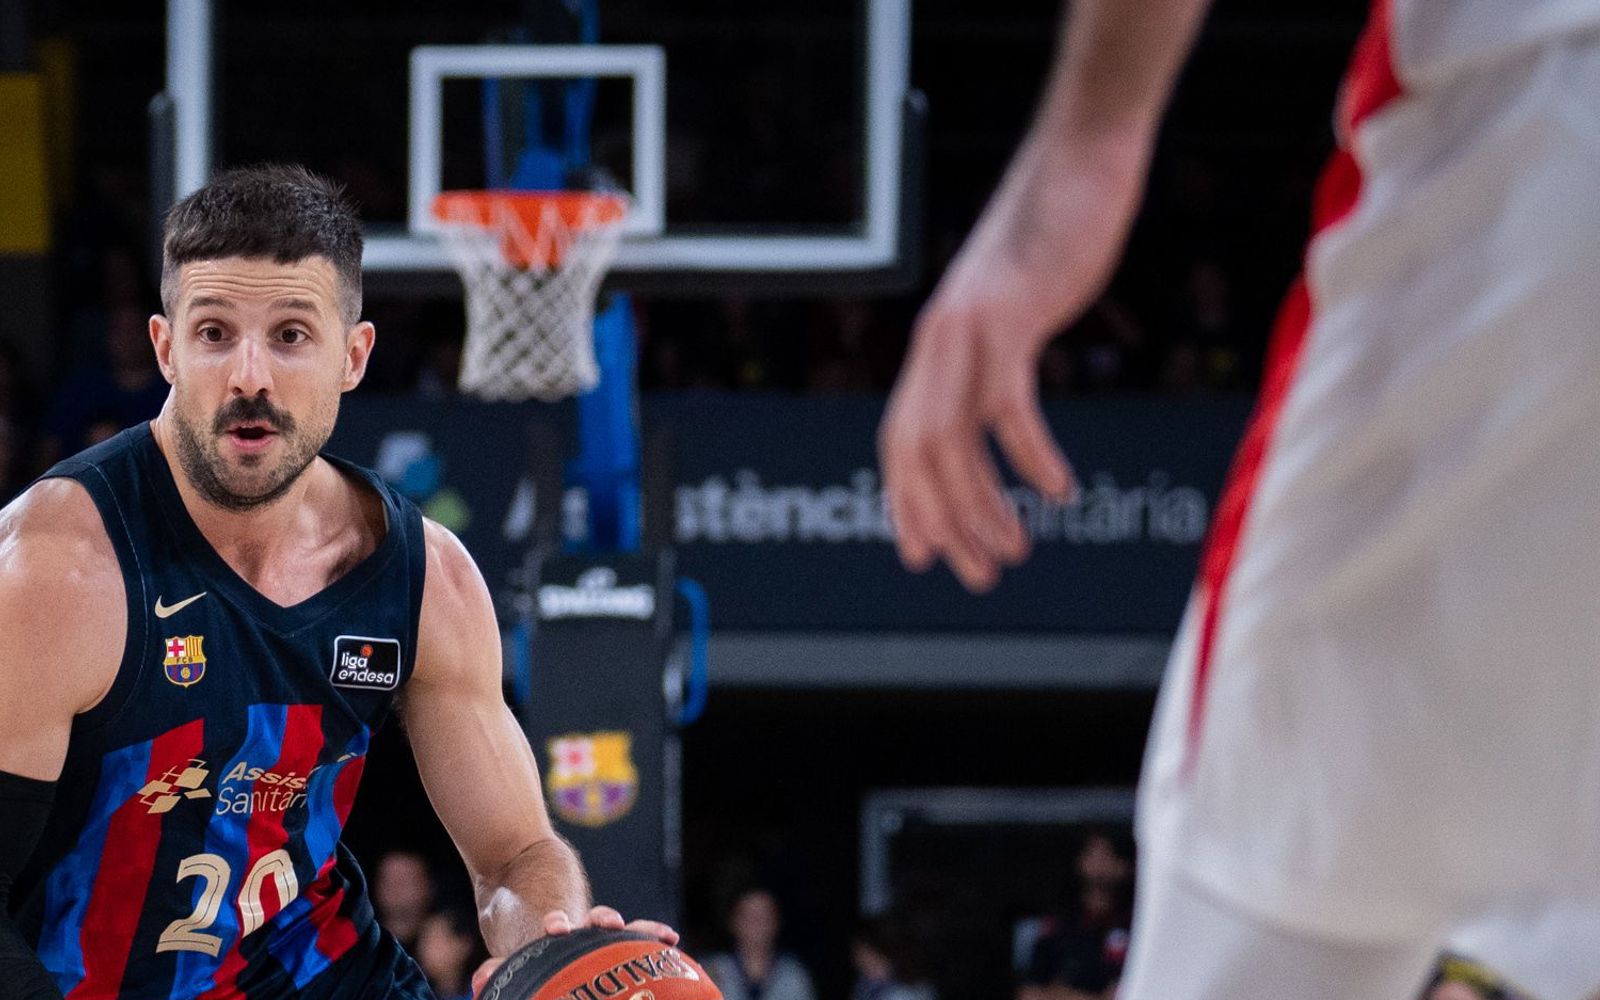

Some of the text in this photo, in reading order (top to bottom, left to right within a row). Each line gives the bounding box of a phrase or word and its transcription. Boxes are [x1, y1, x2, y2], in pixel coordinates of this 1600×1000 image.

[341, 652, 368, 669] liga
[338, 668, 394, 684] endesa
[222, 761, 308, 790] Assis
[155, 848, 299, 958] 20
